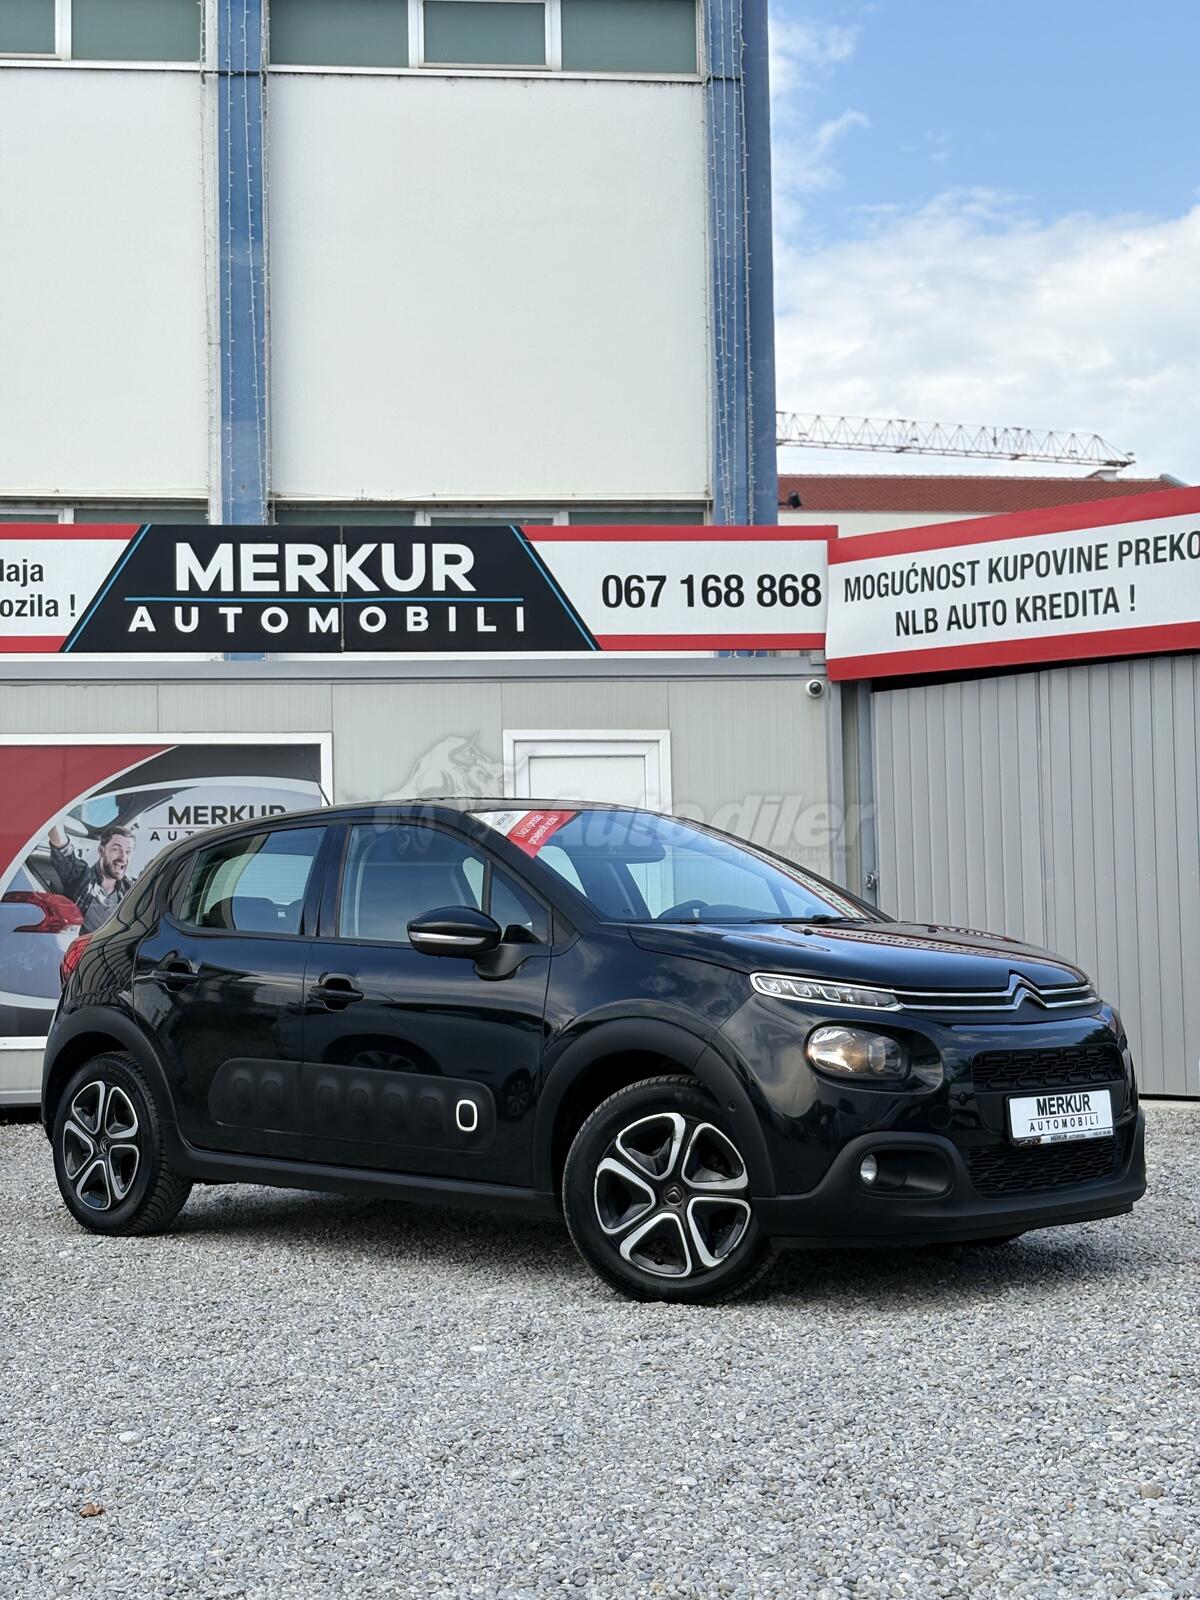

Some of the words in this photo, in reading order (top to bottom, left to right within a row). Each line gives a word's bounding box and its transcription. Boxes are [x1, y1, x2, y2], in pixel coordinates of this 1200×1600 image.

[175, 542, 477, 593] MERKUR
[844, 559, 981, 603] MOGUĆNOST
[988, 543, 1109, 587] KUPOVINE
[1118, 530, 1200, 568] PREKO
[69, 593, 76, 617] !
[601, 574, 667, 608] 067
[680, 574, 745, 608] 168
[756, 573, 822, 608] 868
[128, 605, 525, 634] AUTOMOBILI
[895, 608, 939, 637] NLB
[946, 600, 1007, 632] AUTO
[1016, 587, 1120, 624] KREDITA
[1129, 584, 1136, 612] !
[1036, 1094, 1092, 1117] MERKUR
[1029, 1114, 1099, 1132] AUTOMOBILI
